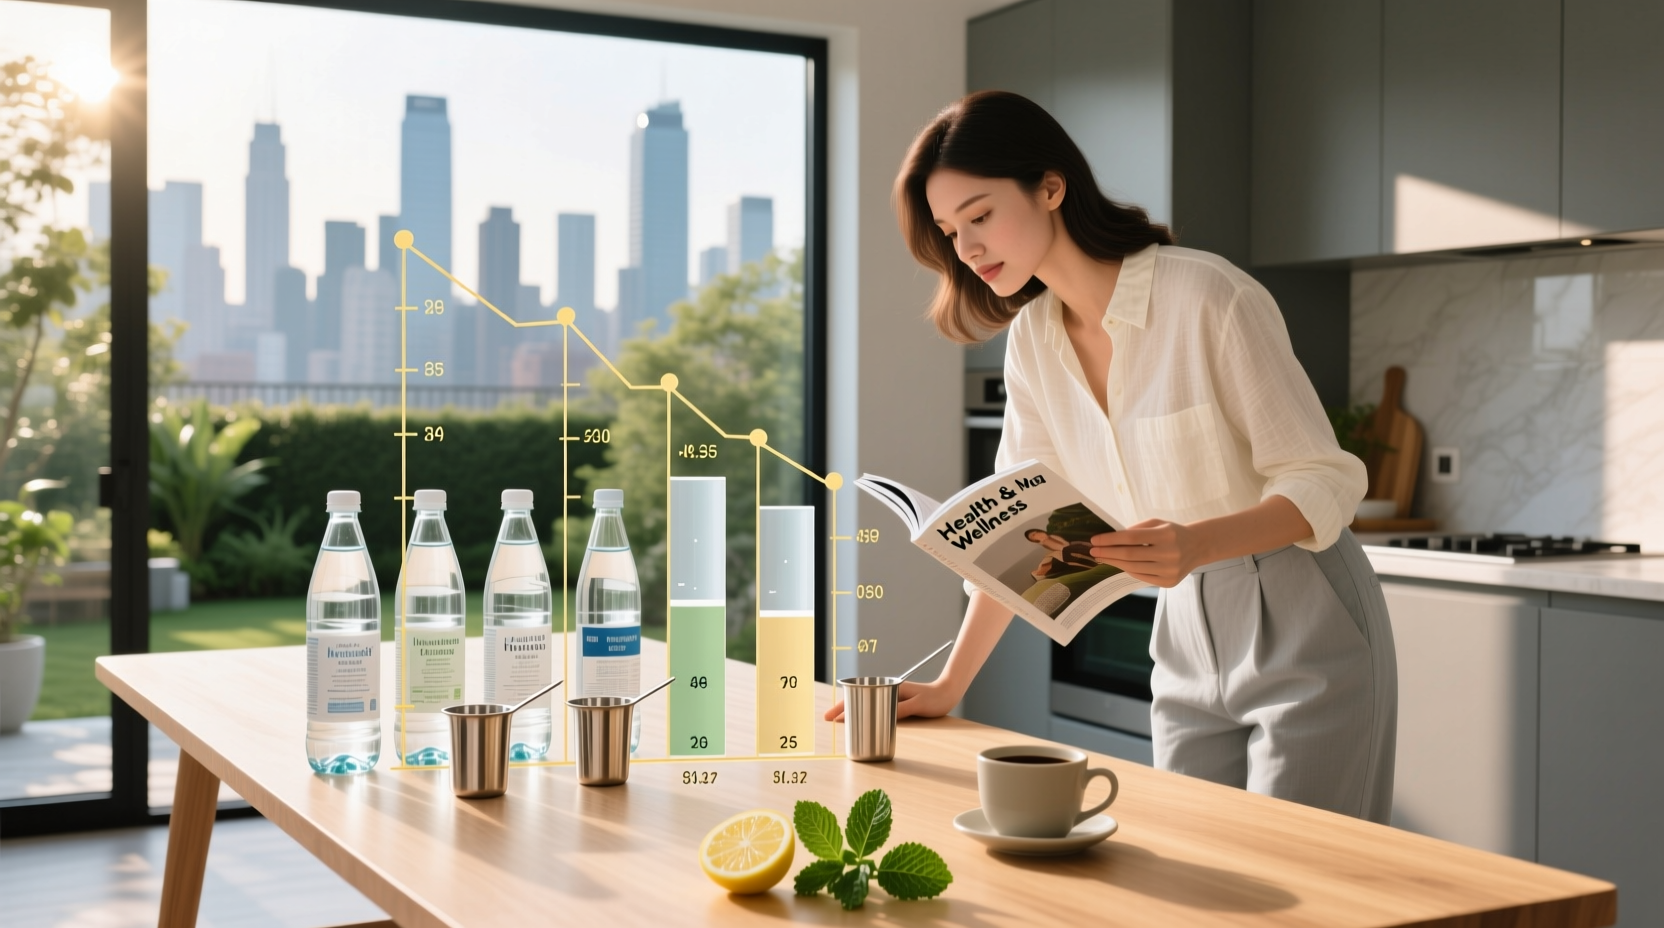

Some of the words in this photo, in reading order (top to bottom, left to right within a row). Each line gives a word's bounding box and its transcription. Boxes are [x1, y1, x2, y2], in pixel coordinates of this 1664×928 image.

[937, 497, 999, 541] Health
[999, 486, 1017, 500] &
[951, 500, 1028, 550] Wellness
